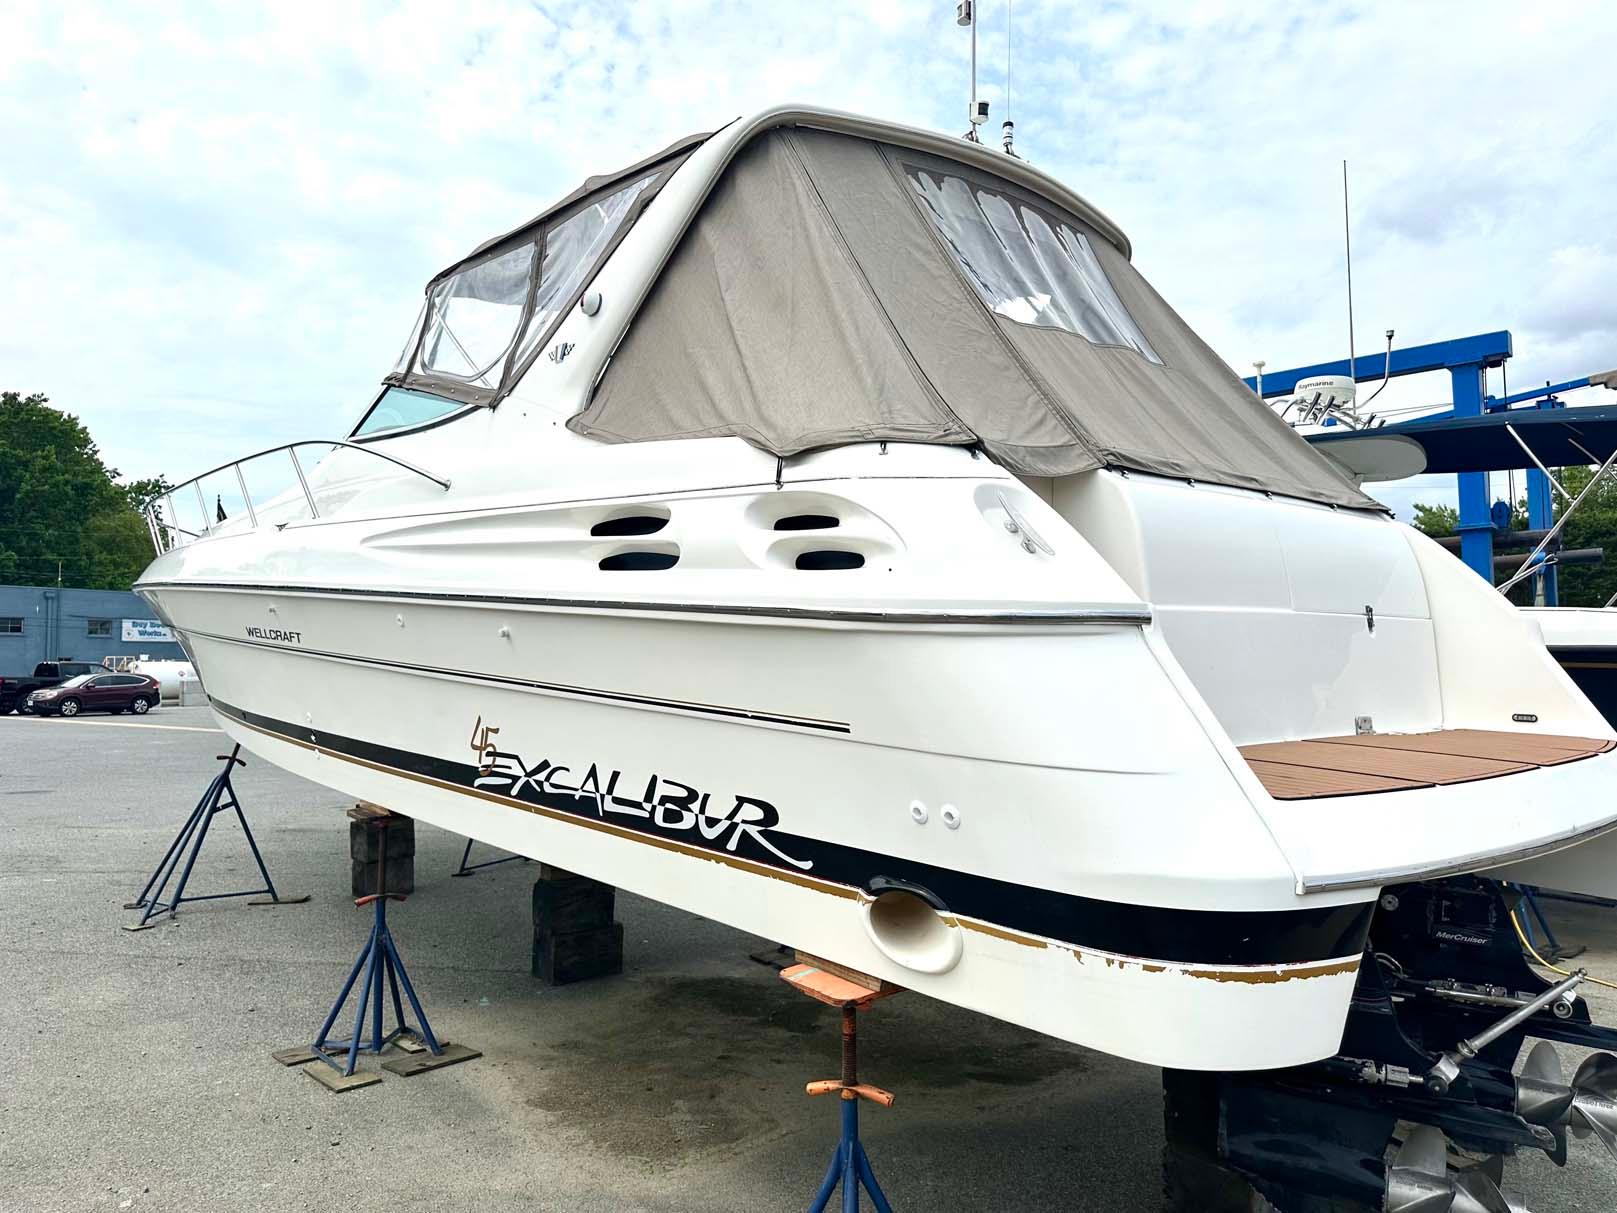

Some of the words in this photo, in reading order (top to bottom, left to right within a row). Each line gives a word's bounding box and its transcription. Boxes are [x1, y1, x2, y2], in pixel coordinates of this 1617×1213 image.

[245, 626, 301, 643] WELLCRAFT
[470, 715, 500, 776] 45
[473, 750, 814, 870] EXCALIBUR
[1436, 931, 1489, 945] MerCruiser
